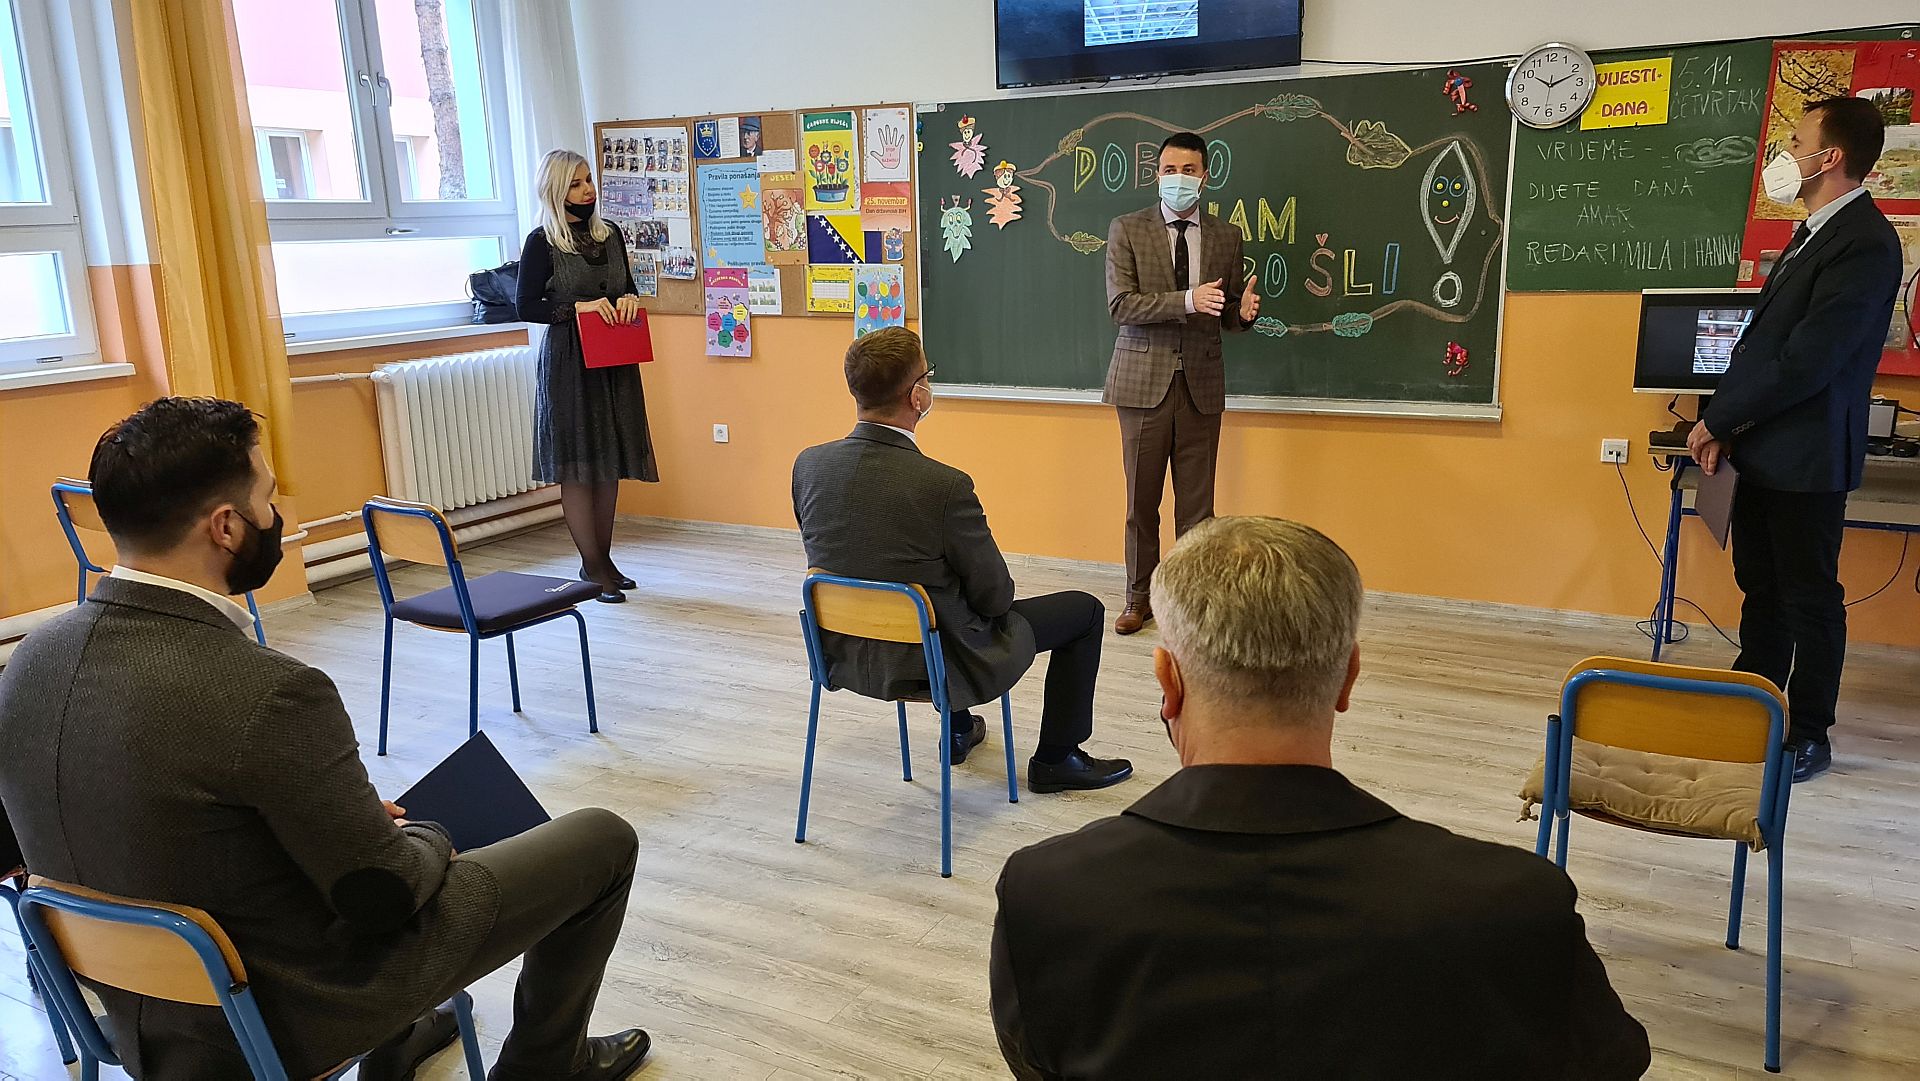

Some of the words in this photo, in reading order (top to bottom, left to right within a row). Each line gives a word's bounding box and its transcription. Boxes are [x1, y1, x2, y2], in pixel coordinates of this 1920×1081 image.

[1545, 53, 1558, 62] 12
[1563, 55, 1568, 64] 1
[1532, 59, 1542, 68] 11
[1572, 64, 1580, 72] 2
[1522, 70, 1534, 79] 10
[1576, 78, 1583, 86] 3
[1518, 84, 1524, 92] 9
[1570, 92, 1578, 101] 4
[1521, 97, 1528, 106] 8
[1533, 106, 1540, 115] 7
[1560, 103, 1567, 112] 5
[1601, 100, 1648, 118] DANA
[1545, 108, 1552, 117] 6
[1537, 139, 1635, 161] VRIJEME
[1075, 139, 1232, 193] DOBO
[1529, 181, 1600, 201] DIJETE
[1634, 176, 1694, 198] DANA
[1576, 204, 1634, 229] AMAR
